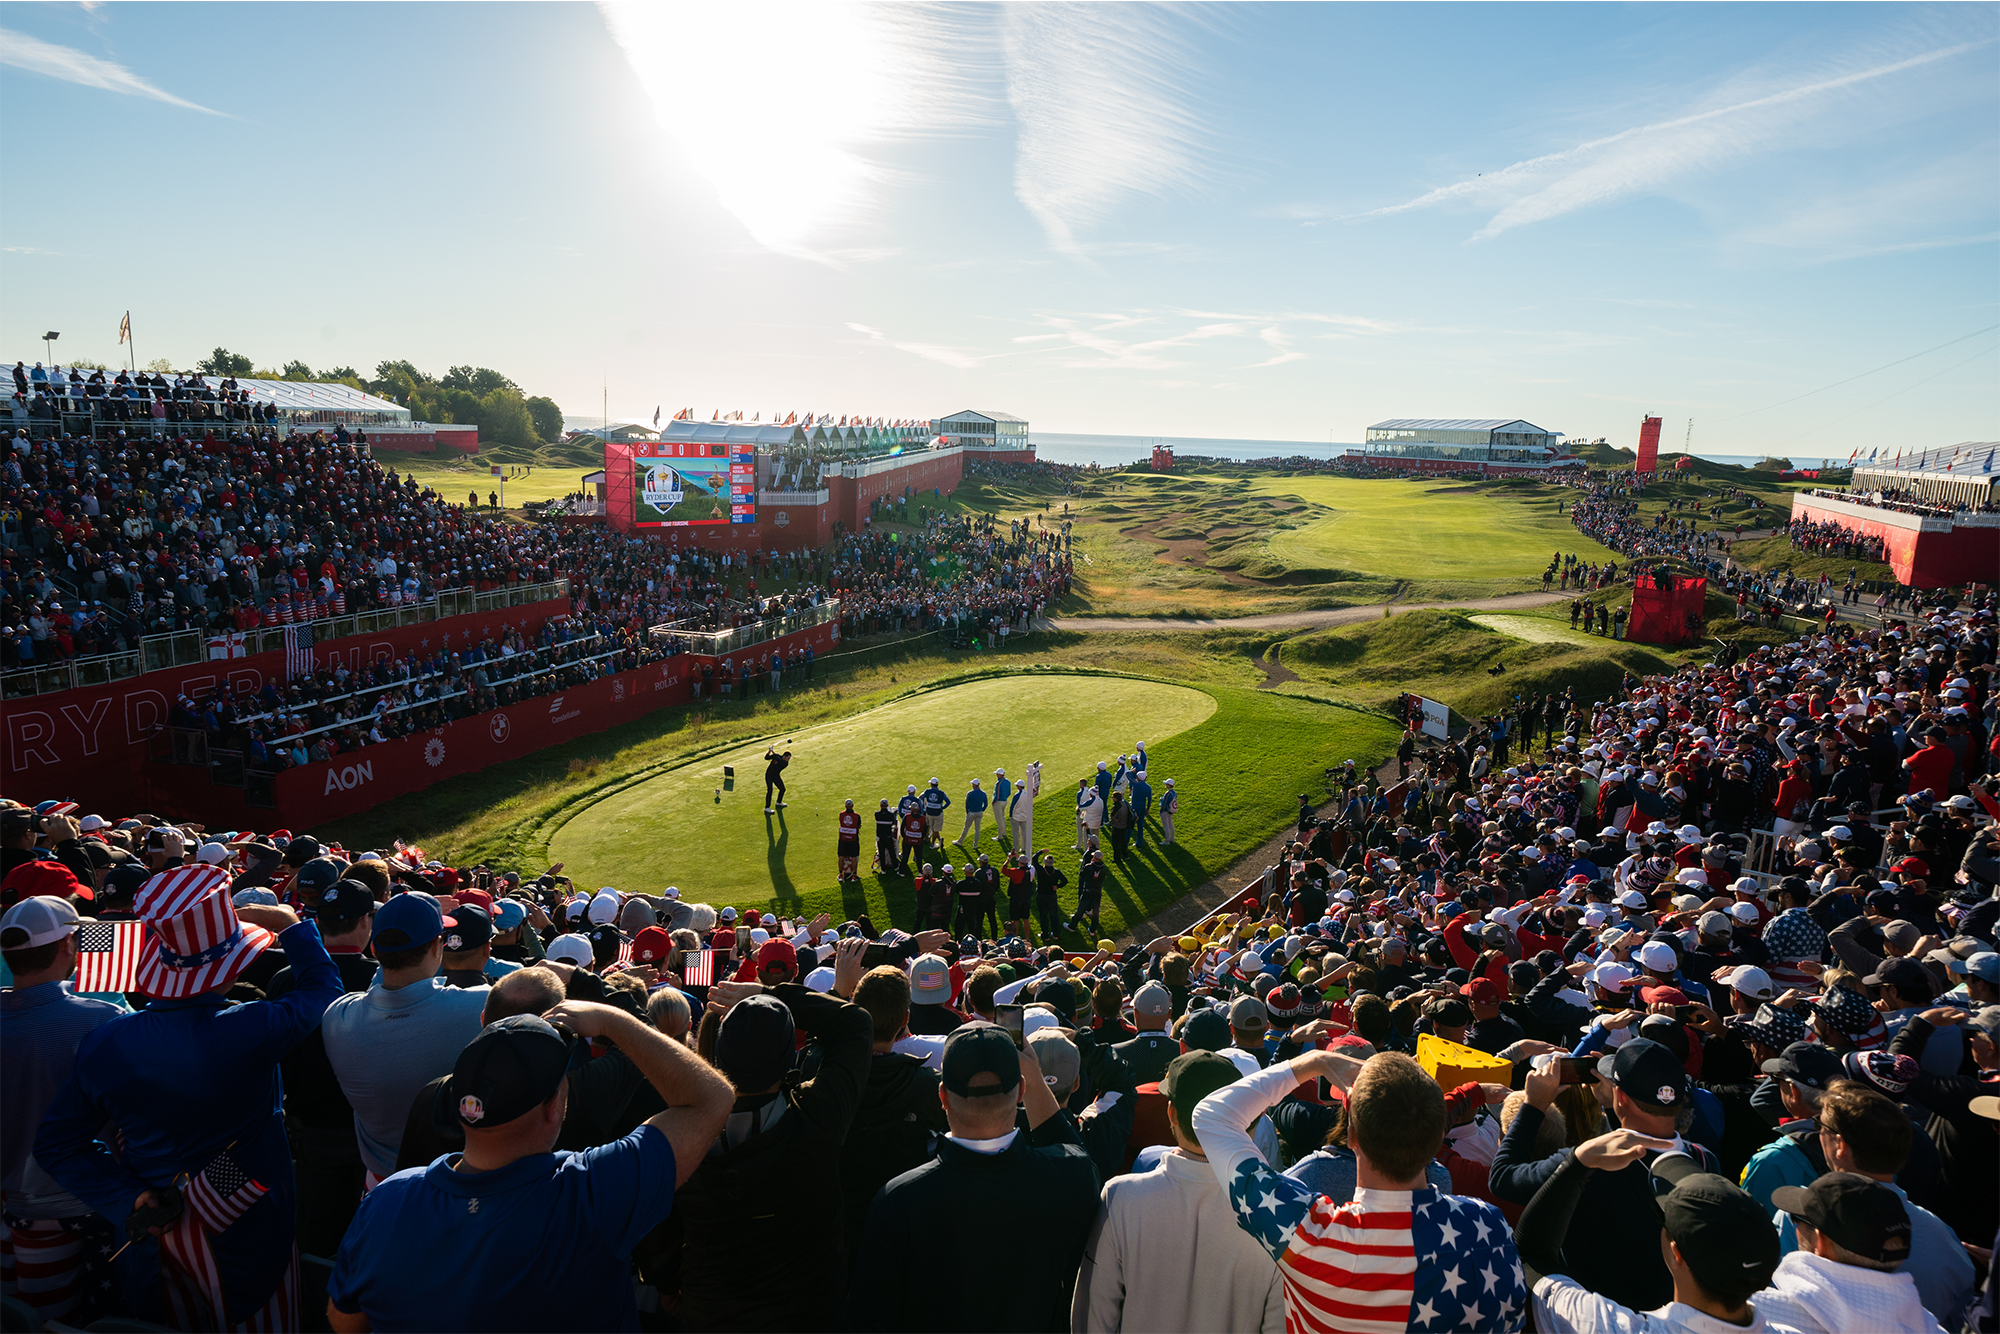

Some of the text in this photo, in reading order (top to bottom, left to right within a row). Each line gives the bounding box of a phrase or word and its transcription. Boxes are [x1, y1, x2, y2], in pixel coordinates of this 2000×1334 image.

[679, 444, 705, 456] 0 0
[668, 493, 682, 501] CUP
[654, 675, 679, 691] ROLEX
[552, 709, 581, 724] Constellation
[1430, 714, 1445, 727] PGA
[435, 727, 444, 736] bp
[324, 759, 374, 796] AON
